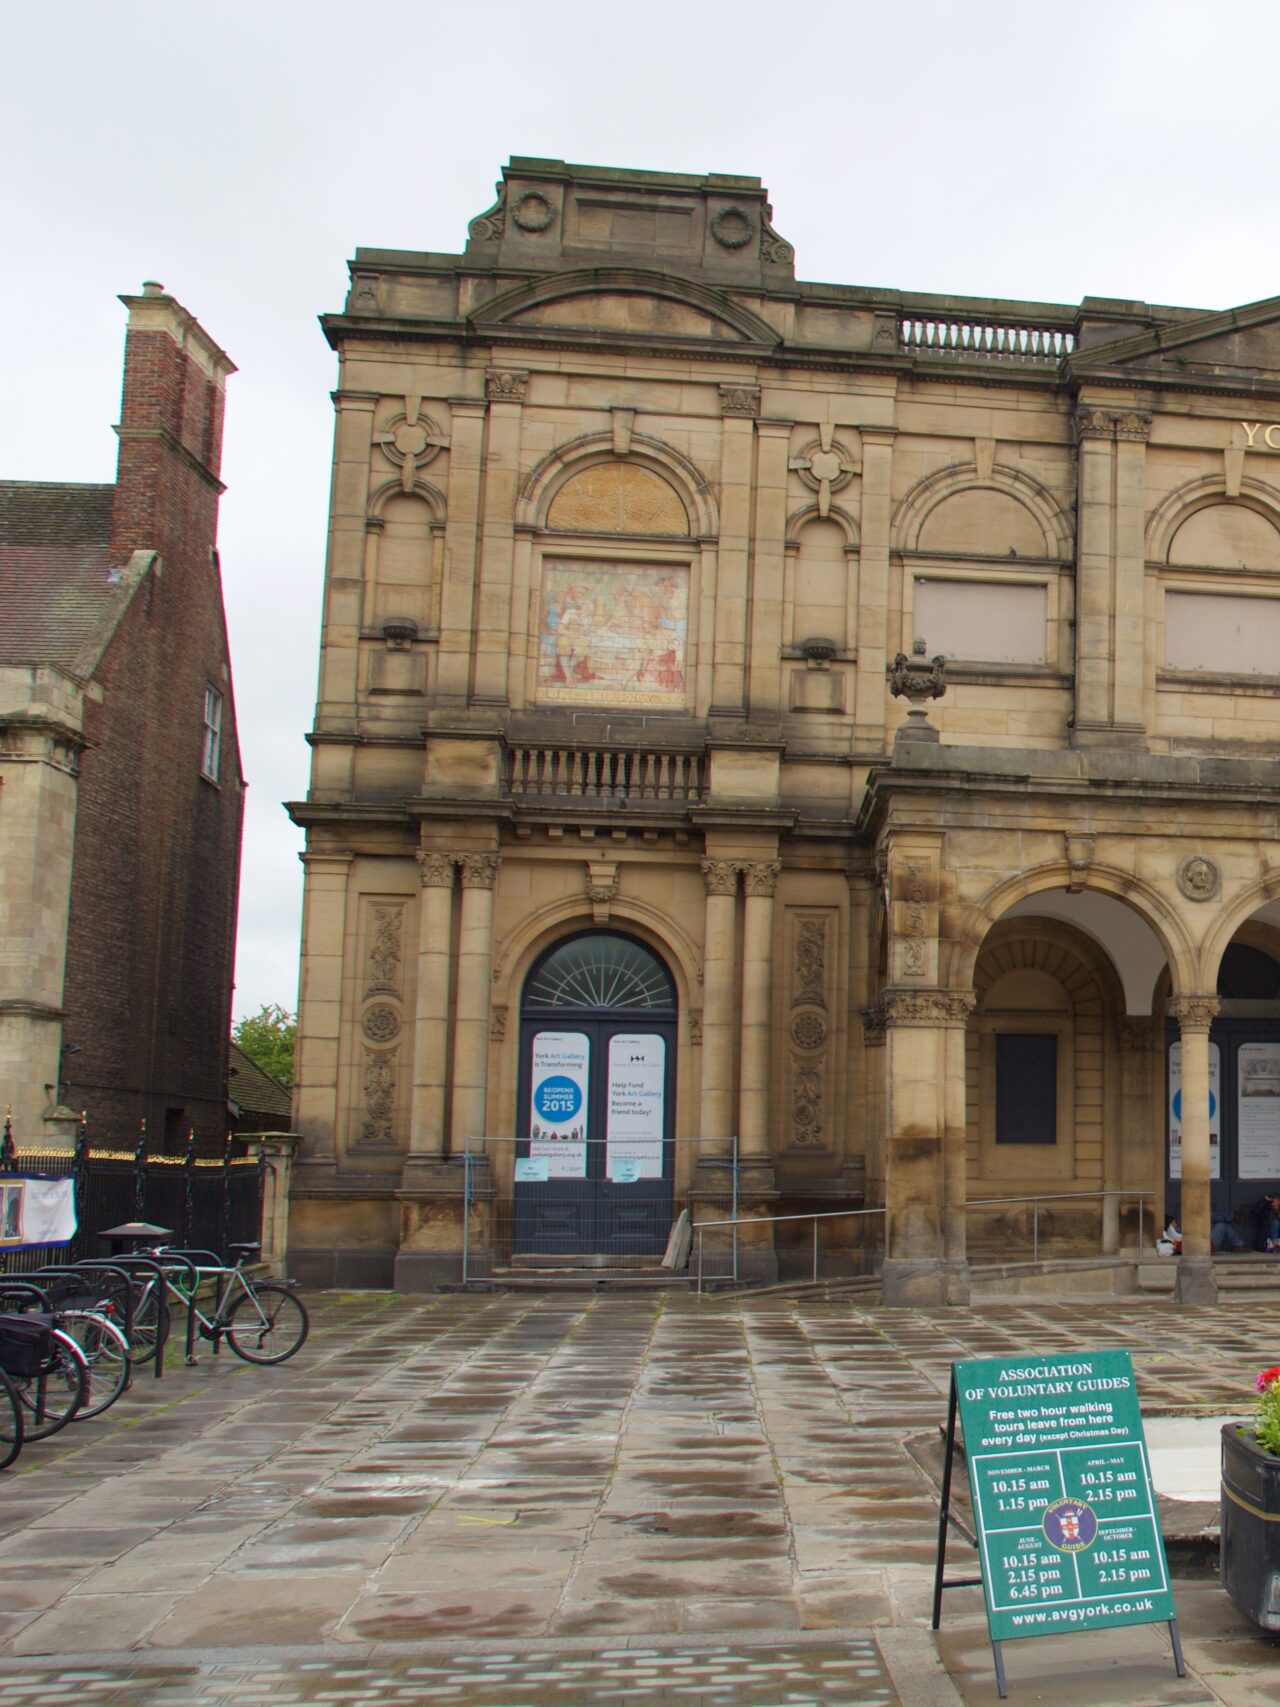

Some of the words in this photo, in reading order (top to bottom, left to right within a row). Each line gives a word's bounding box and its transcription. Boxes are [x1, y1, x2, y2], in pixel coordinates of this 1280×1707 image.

[541, 1061, 583, 1069] Transforming
[639, 1090, 661, 1098] Gallery
[542, 1101, 575, 1111] 2015
[1000, 1363, 1093, 1381] ASSOCIATION
[965, 1389, 985, 1400] OF
[988, 1381, 1074, 1399] VOLUNTARY
[1077, 1377, 1130, 1391] GUIDES
[989, 1409, 1014, 1420] Free
[1017, 1407, 1038, 1418] two
[1041, 1405, 1067, 1416] hour
[1069, 1402, 1113, 1414] walking
[994, 1422, 1025, 1432] tours
[1028, 1419, 1057, 1430] leave
[1059, 1416, 1086, 1427] from
[1088, 1414, 1113, 1424] here
[981, 1435, 1013, 1446] every
[1016, 1432, 1037, 1444] day
[1039, 1432, 1068, 1442] (except
[1069, 1429, 1109, 1438] Christmas
[1111, 1427, 1129, 1436] Day)
[1087, 1458, 1106, 1466] APRIL
[987, 1467, 1023, 1475] NOVEMBER
[1027, 1465, 1050, 1473] MARCH
[1080, 1471, 1114, 1485] 10.15
[1117, 1471, 1137, 1481] am
[991, 1479, 1026, 1494] 10.15
[1029, 1479, 1050, 1489] am
[1086, 1488, 1113, 1502] 2.15
[1116, 1488, 1137, 1499] pm
[998, 1497, 1025, 1511] 1.15
[1028, 1499, 1049, 1511] pm
[1048, 1499, 1089, 1513] VOLUNTARY
[1098, 1527, 1133, 1536] SEPTEMBER
[1103, 1532, 1133, 1541] OCTOBER
[1017, 1542, 1042, 1550] AUGUST
[1061, 1542, 1086, 1550] GUIDE
[1002, 1553, 1037, 1569] 10.15
[1040, 1553, 1061, 1565] am
[1093, 1549, 1127, 1564] 10.15
[1130, 1549, 1151, 1560] am
[1008, 1569, 1035, 1583] 2.15
[1039, 1569, 1060, 1583] pm
[1099, 1568, 1126, 1582] 2.15
[1130, 1568, 1151, 1582] pm
[1010, 1584, 1038, 1599] 6.45
[1041, 1583, 1063, 1598] pm
[1012, 1598, 1153, 1624] www.avgyork.co.uk
